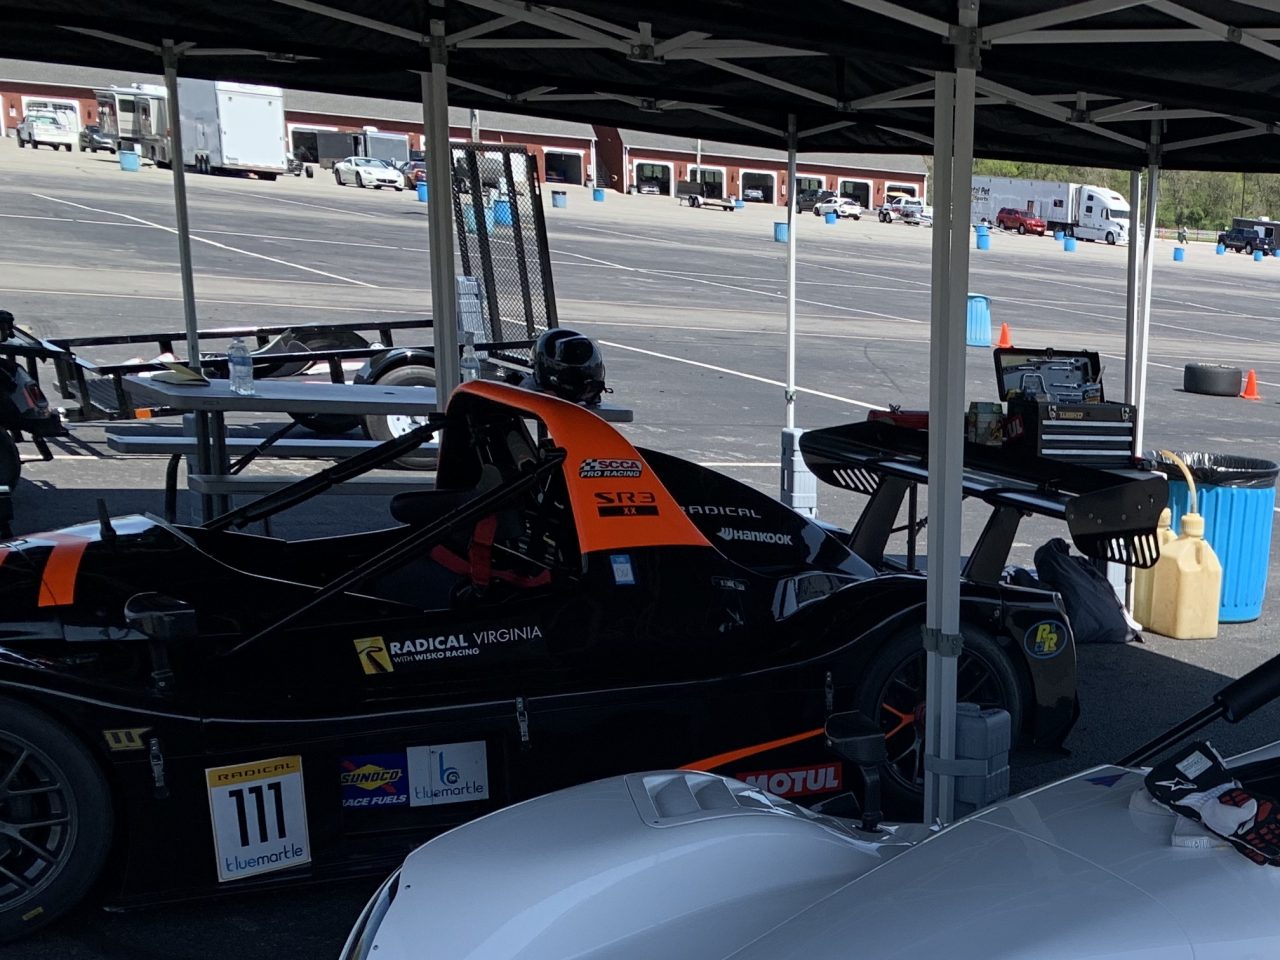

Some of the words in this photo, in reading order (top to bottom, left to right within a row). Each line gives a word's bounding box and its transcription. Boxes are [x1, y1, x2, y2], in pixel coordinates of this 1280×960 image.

[598, 460, 640, 469] SCCA
[580, 470, 602, 478] PRO
[594, 491, 656, 505] SR3
[389, 633, 469, 655] RADICAL
[472, 625, 543, 645] VIRGINIA
[392, 655, 414, 664] WITH
[414, 651, 445, 662] WISKO
[445, 647, 480, 658] RACING
[217, 762, 296, 781] RADICAL
[341, 769, 400, 784] SUNOCO
[744, 766, 840, 796] MOTUL
[370, 794, 408, 805] FUELS
[228, 781, 287, 847] 111
